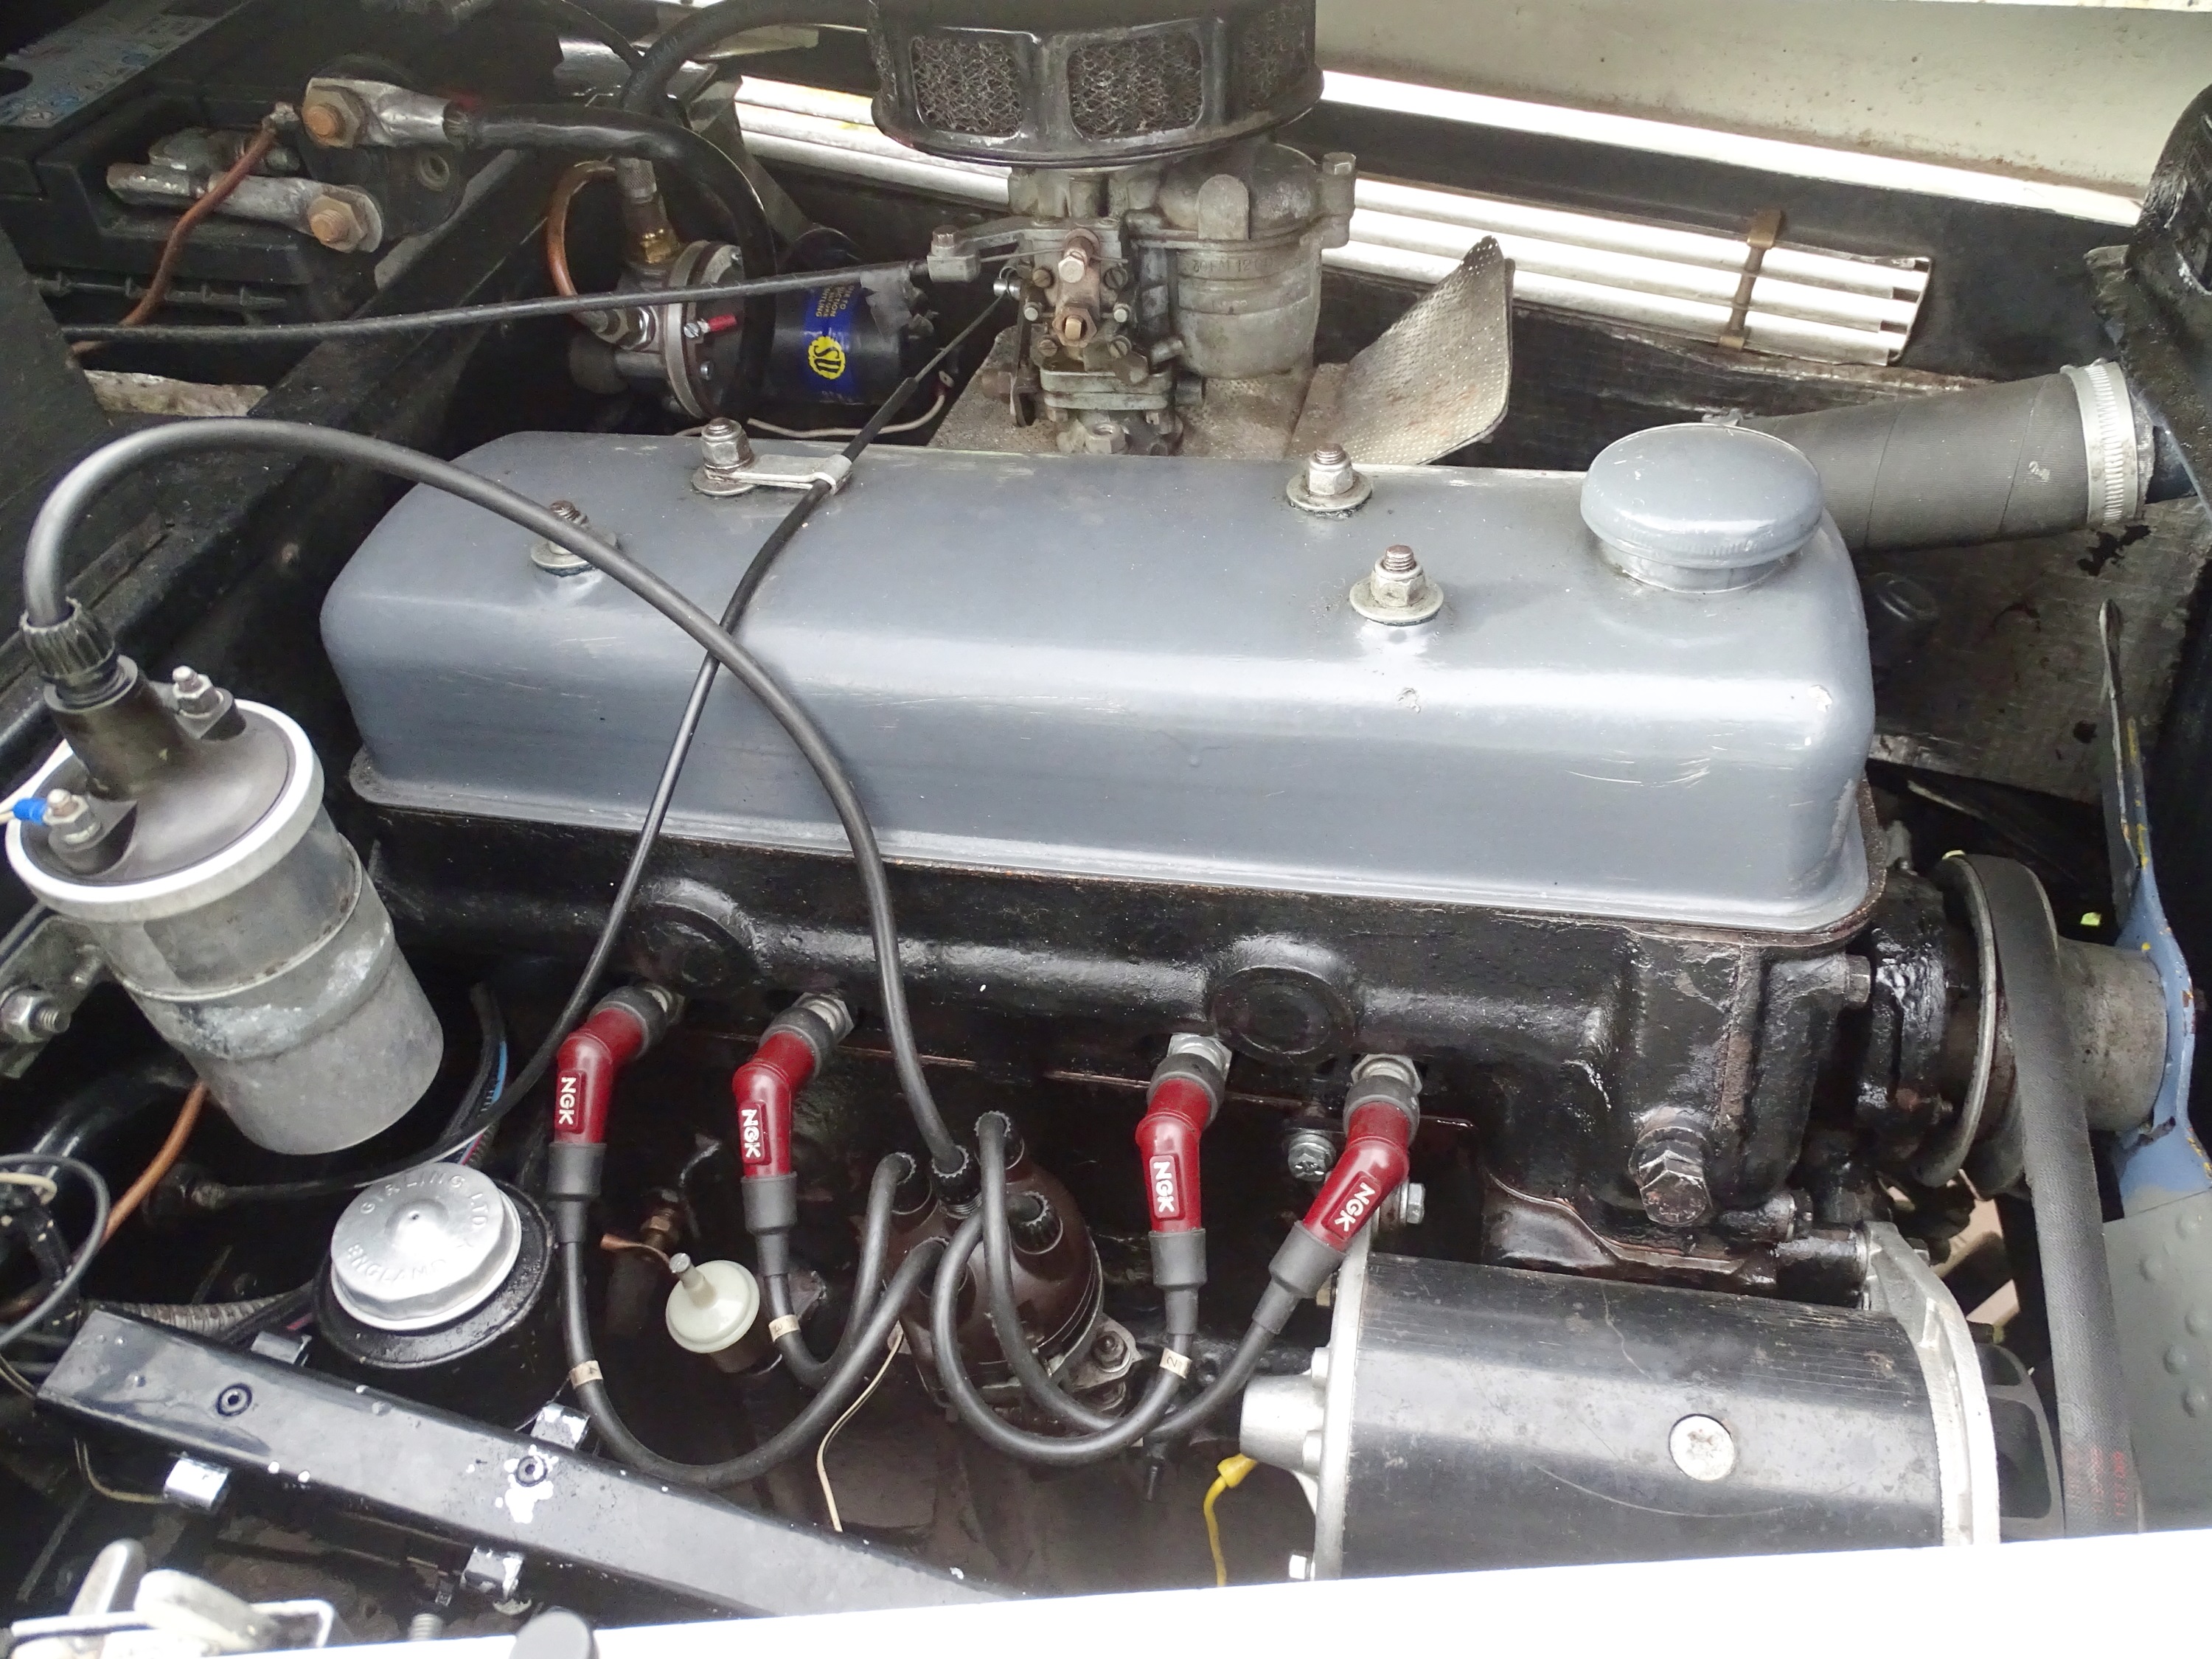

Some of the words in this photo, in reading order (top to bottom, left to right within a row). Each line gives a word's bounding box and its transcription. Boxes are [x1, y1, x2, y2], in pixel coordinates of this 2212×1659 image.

[813, 345, 841, 374] SU
[558, 1077, 577, 1125] NGK
[741, 1108, 762, 1158] NGK
[359, 1172, 465, 1214] GIRLING
[1153, 1161, 1175, 1213] NGK
[1335, 1182, 1376, 1231] NGK
[1166, 1356, 1178, 1368] 2
